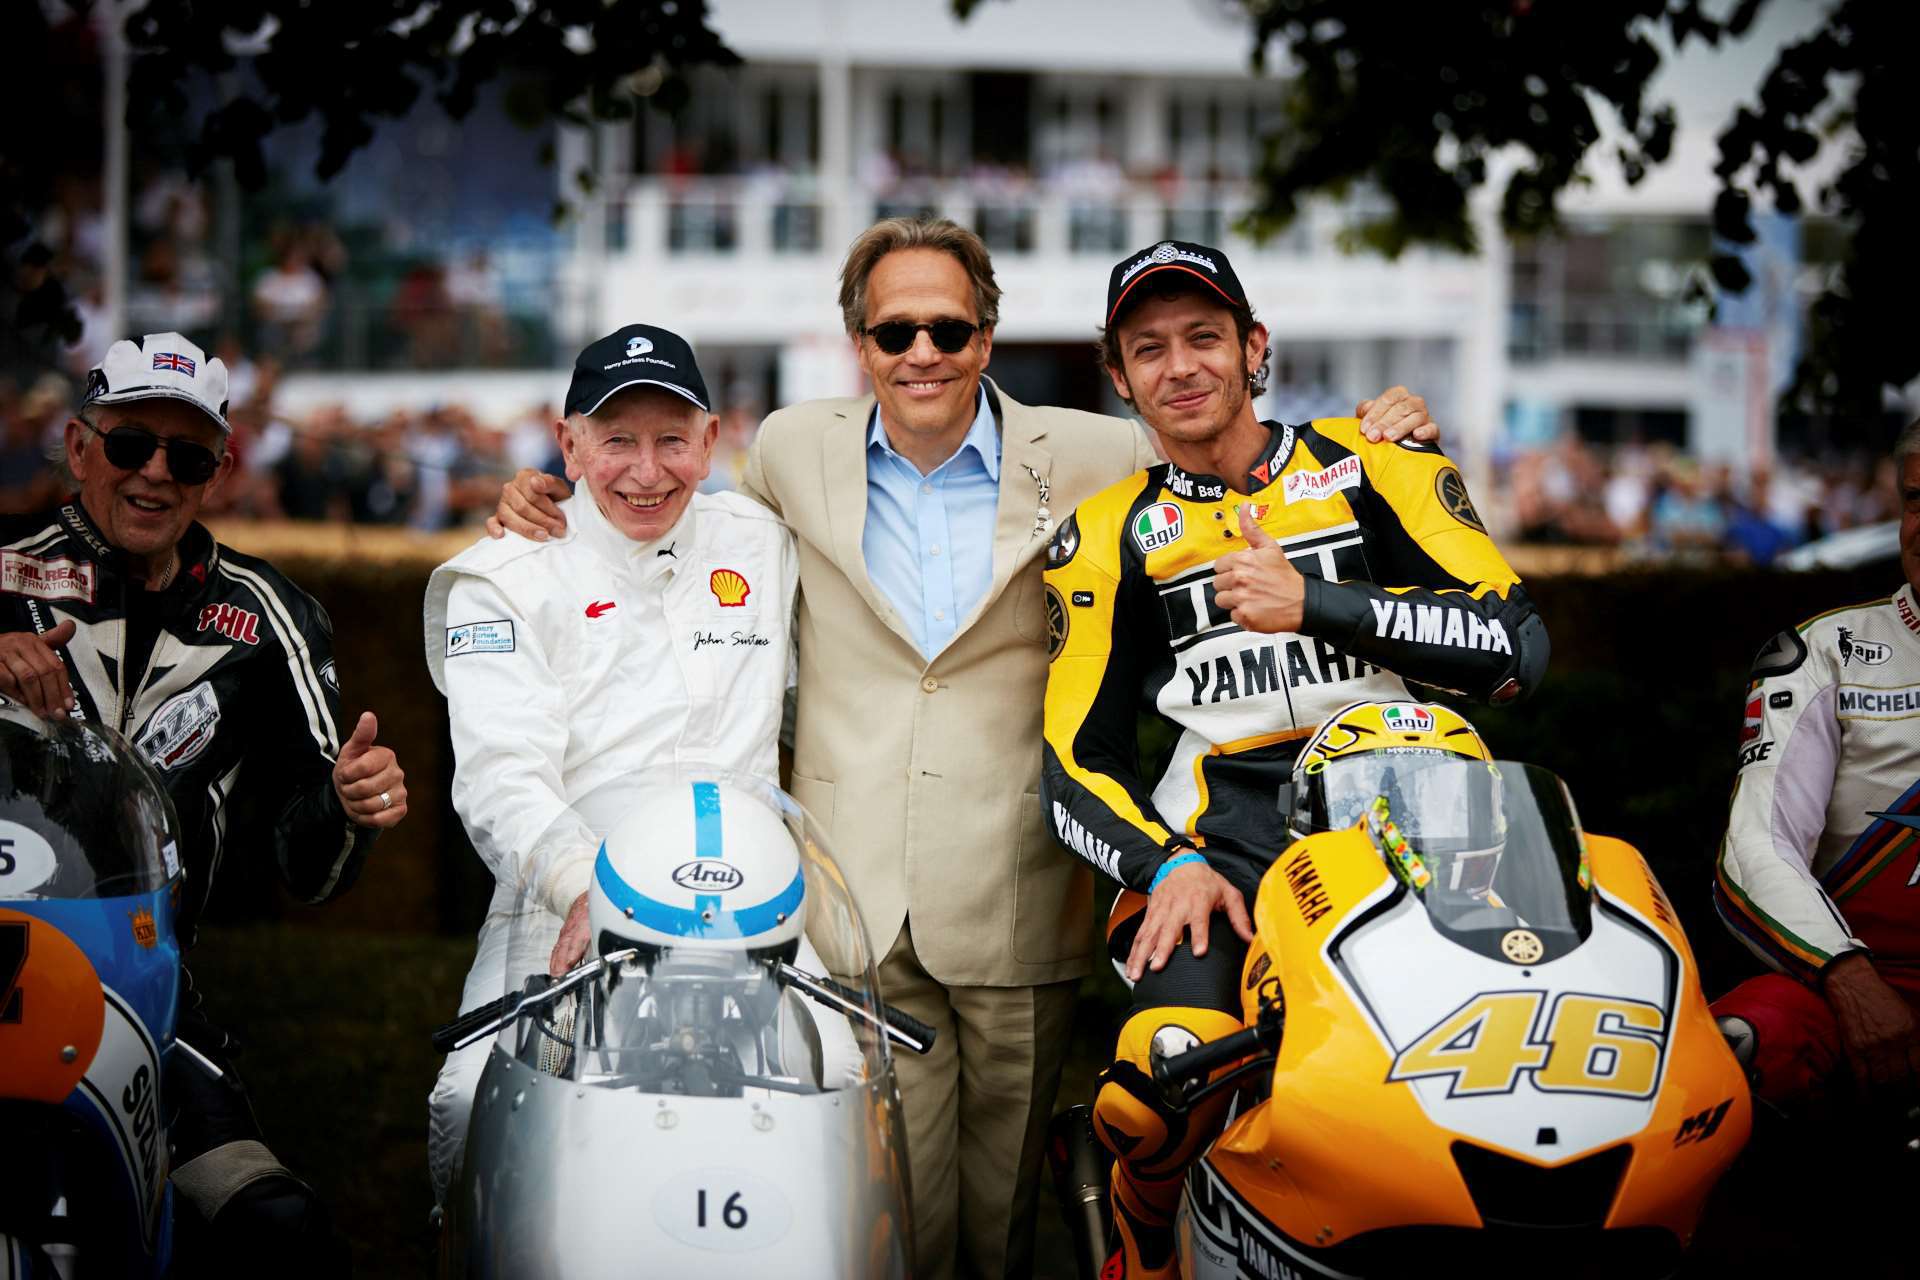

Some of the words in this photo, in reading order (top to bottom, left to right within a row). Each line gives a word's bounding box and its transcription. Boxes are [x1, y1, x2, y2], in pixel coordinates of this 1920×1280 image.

[1302, 458, 1359, 489] YAMAHA
[1197, 485, 1224, 499] Bag
[1145, 525, 1179, 548] agv
[5, 560, 42, 580] PHIL
[45, 567, 89, 586] READ
[197, 602, 260, 646] PHIL
[1369, 598, 1513, 656] YAMAHA
[693, 631, 725, 651] John
[1854, 644, 1883, 662] api
[1391, 717, 1429, 730] agv
[1053, 800, 1128, 888] YAMAHA
[677, 863, 737, 883] Arai
[1284, 849, 1333, 928] YAMAHA
[1384, 989, 1667, 1102] 46
[696, 1188, 749, 1229] 16
